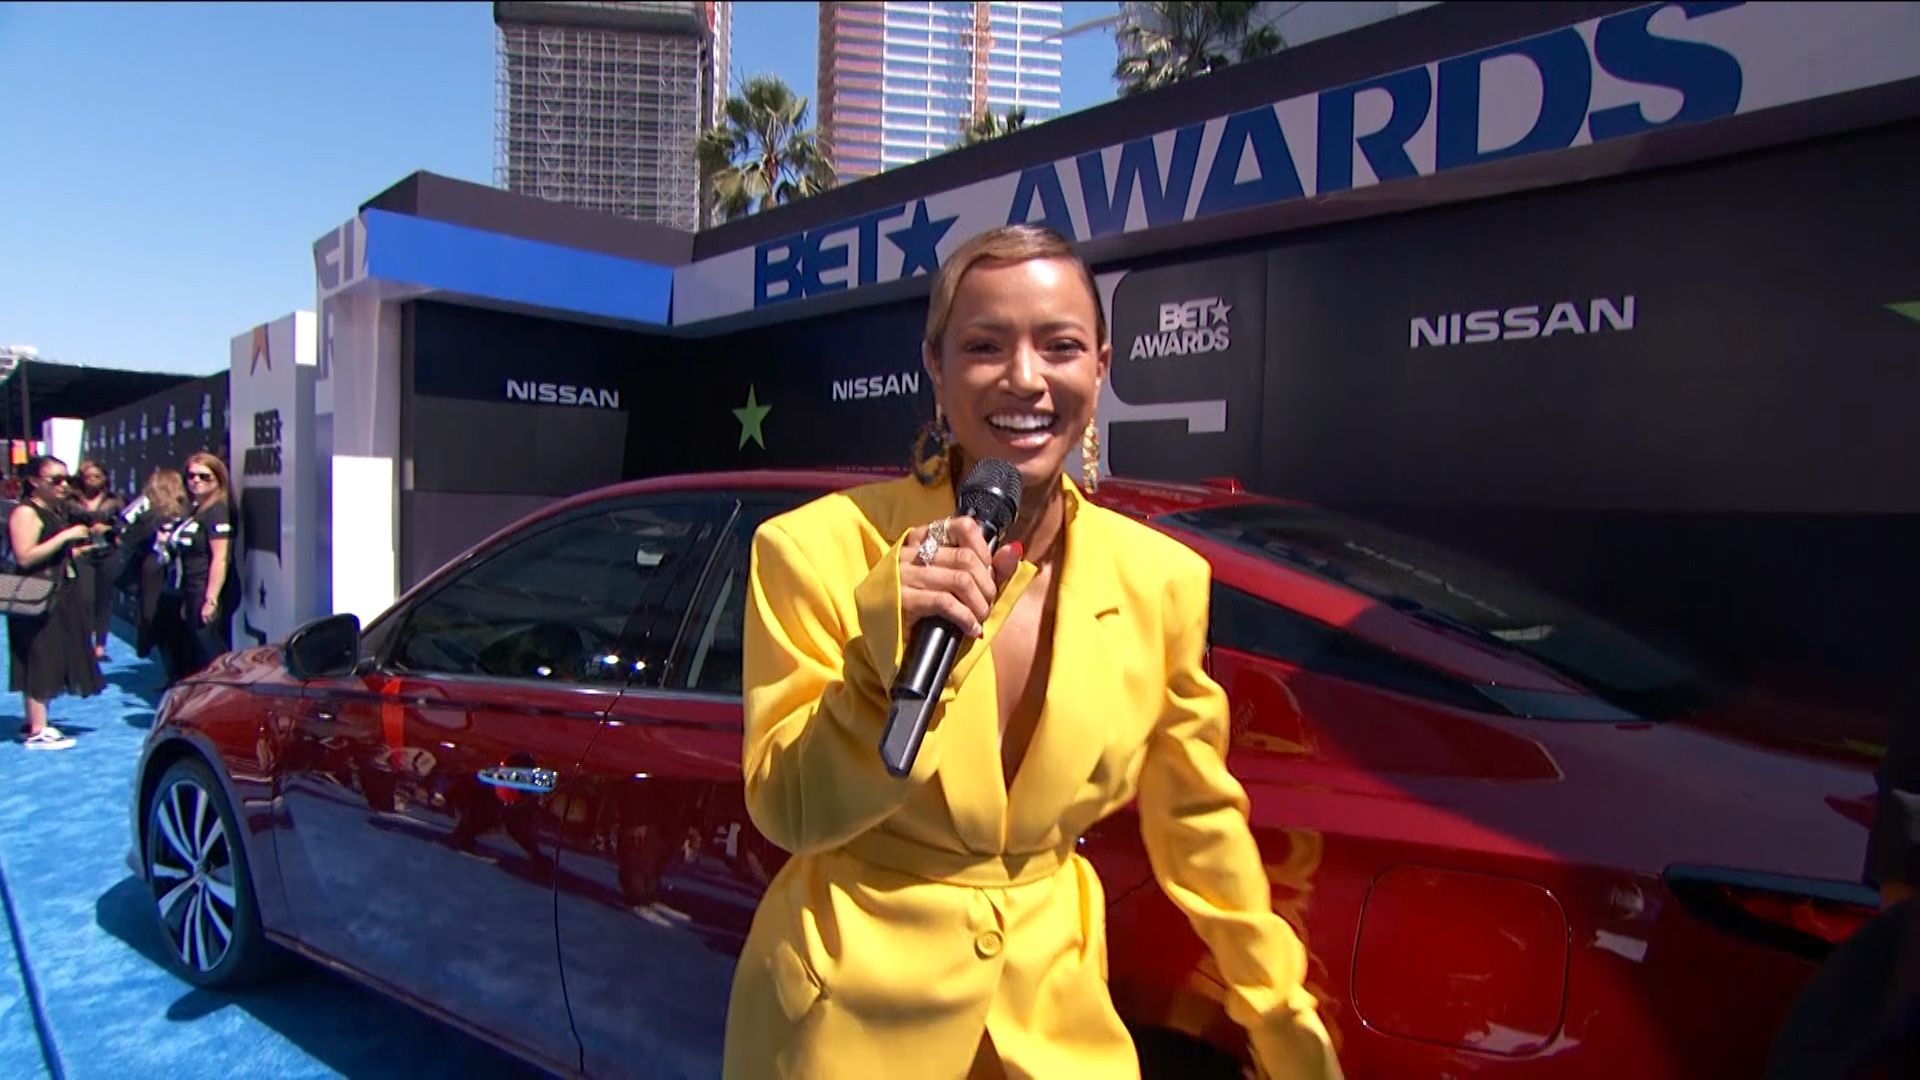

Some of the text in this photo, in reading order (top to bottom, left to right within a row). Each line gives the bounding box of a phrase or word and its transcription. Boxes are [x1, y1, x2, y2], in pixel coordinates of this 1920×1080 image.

[754, 1, 1746, 309] BET AWARDS
[1159, 297, 1218, 332] BET
[1409, 295, 1635, 348] NISSAN
[1129, 325, 1230, 361] AWARDS
[506, 379, 619, 408] NISSAN
[832, 371, 920, 401] NISSAN
